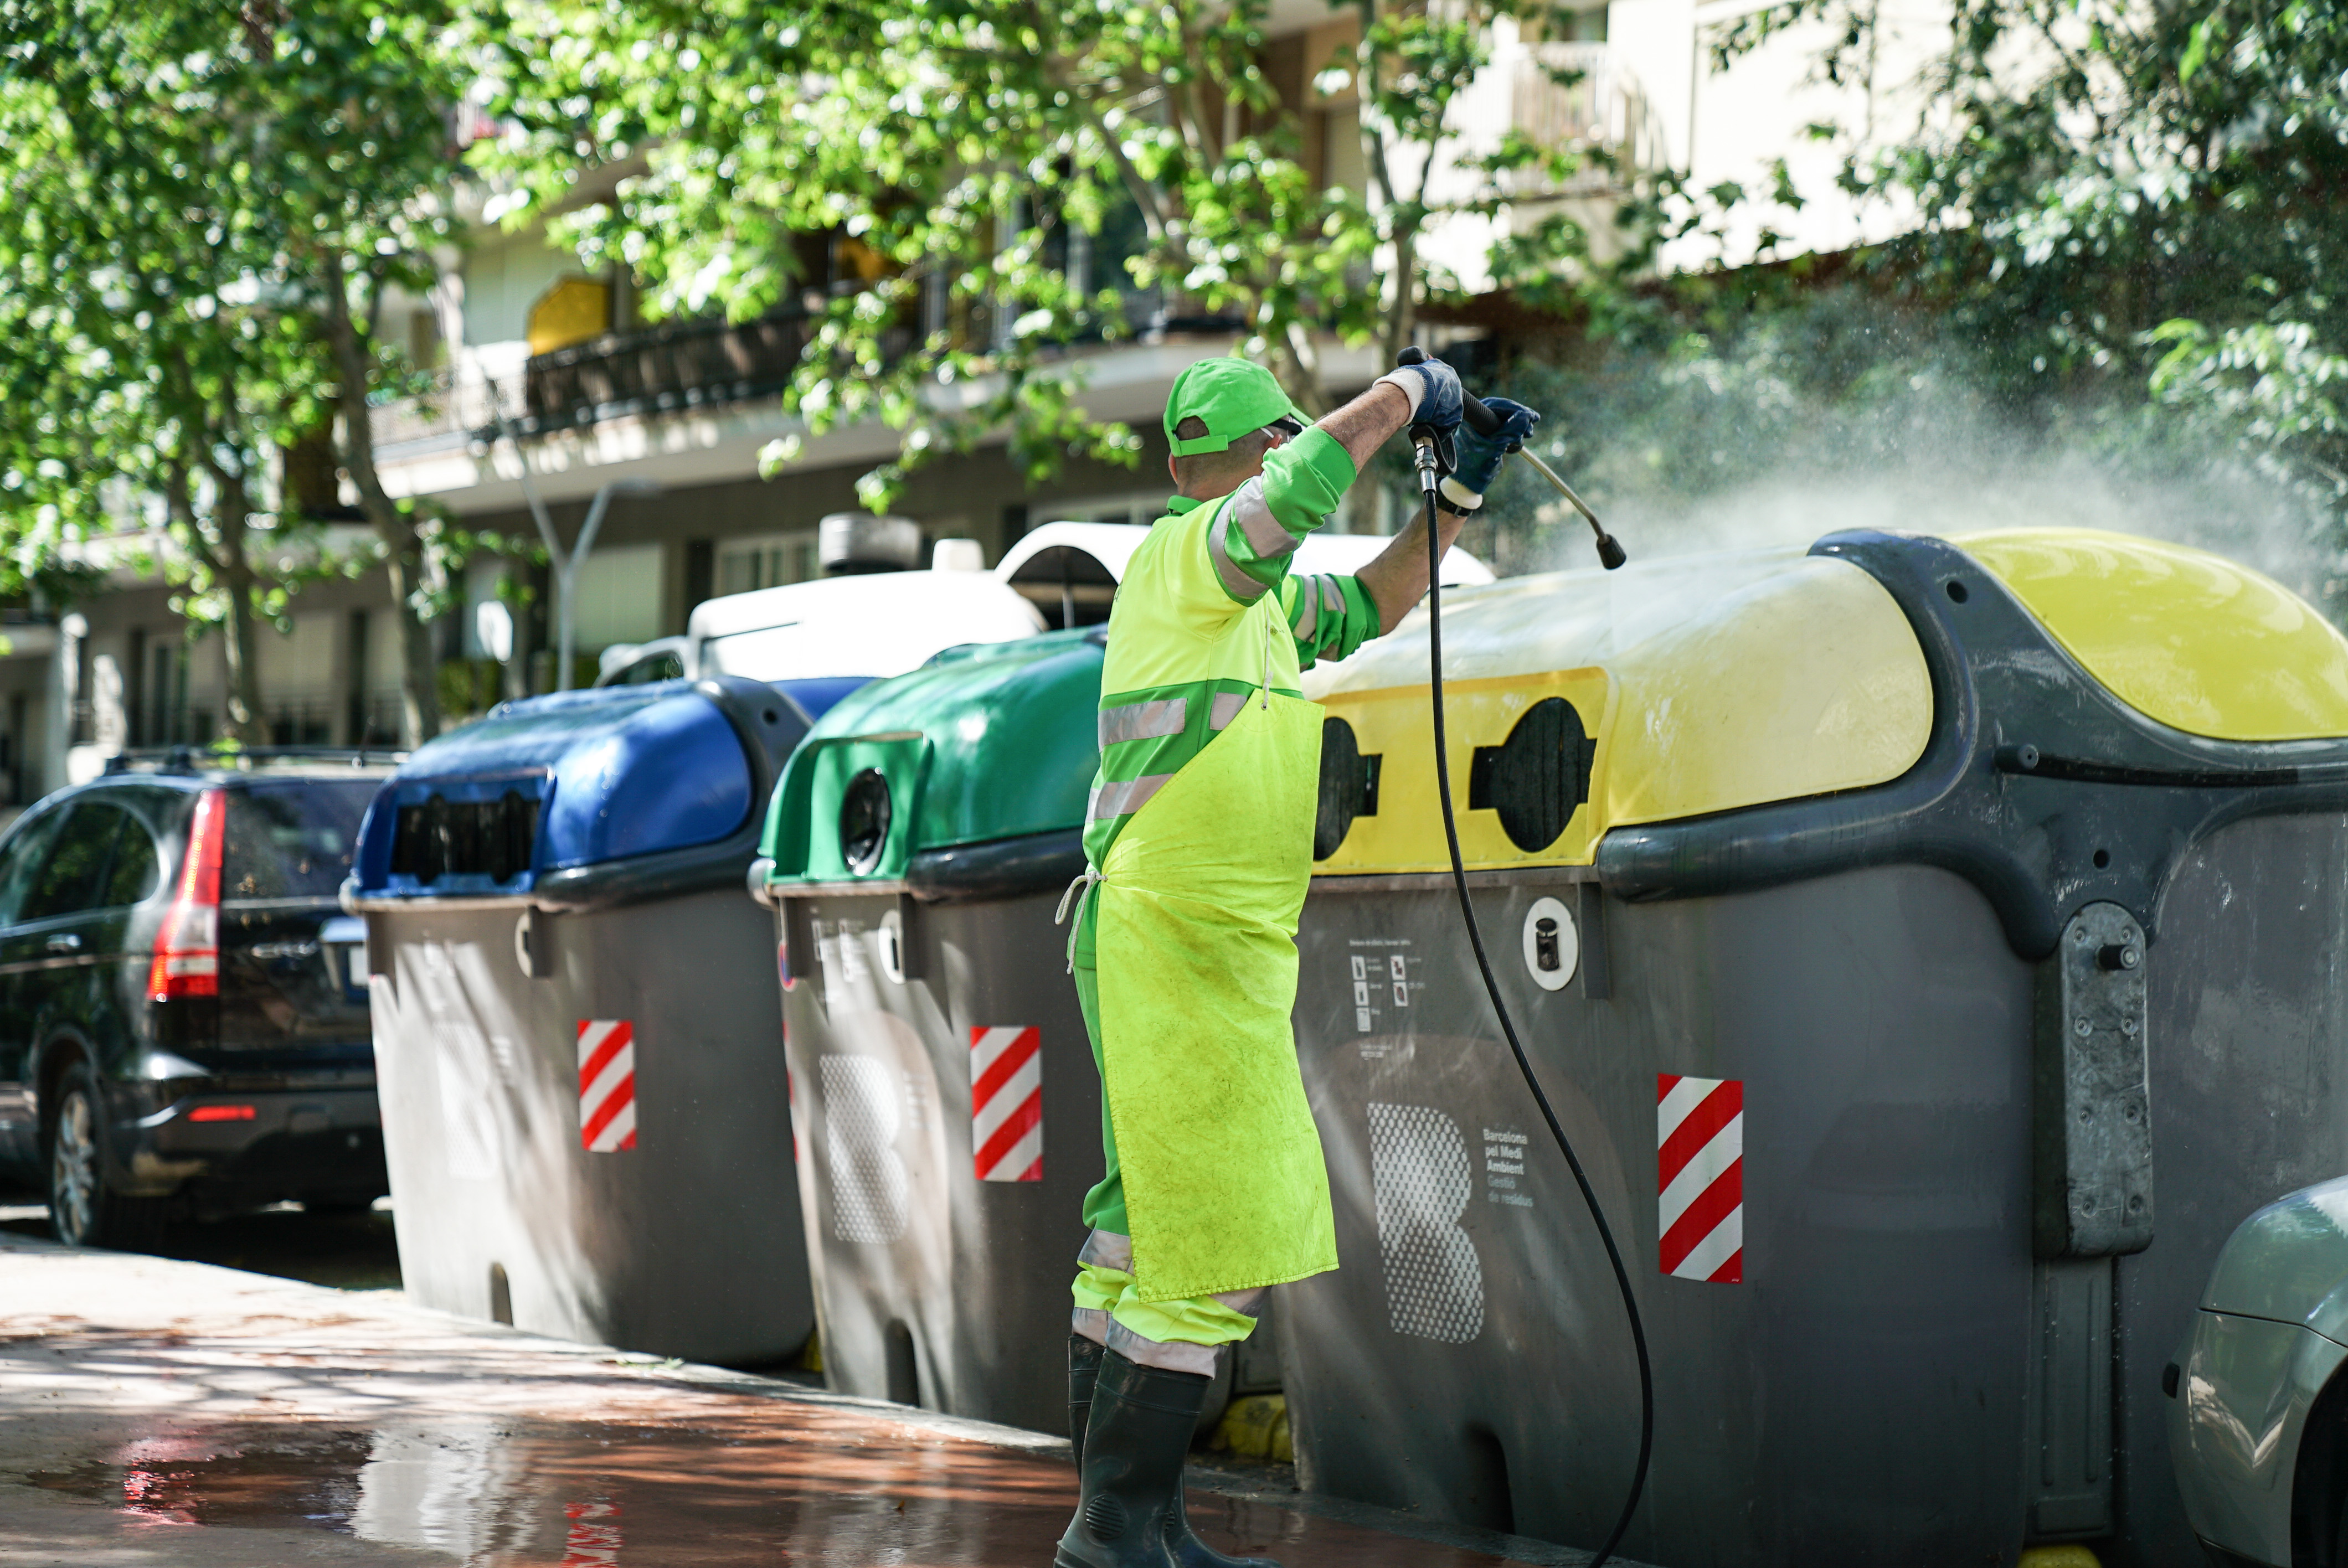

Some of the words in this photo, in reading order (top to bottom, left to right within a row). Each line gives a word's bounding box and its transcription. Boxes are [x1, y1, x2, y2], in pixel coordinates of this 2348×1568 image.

[1483, 1128, 1528, 1146] Barcelona
[1485, 1144, 1499, 1158] pel
[1500, 1146, 1522, 1160] Medi
[1487, 1159, 1524, 1175] Ambient
